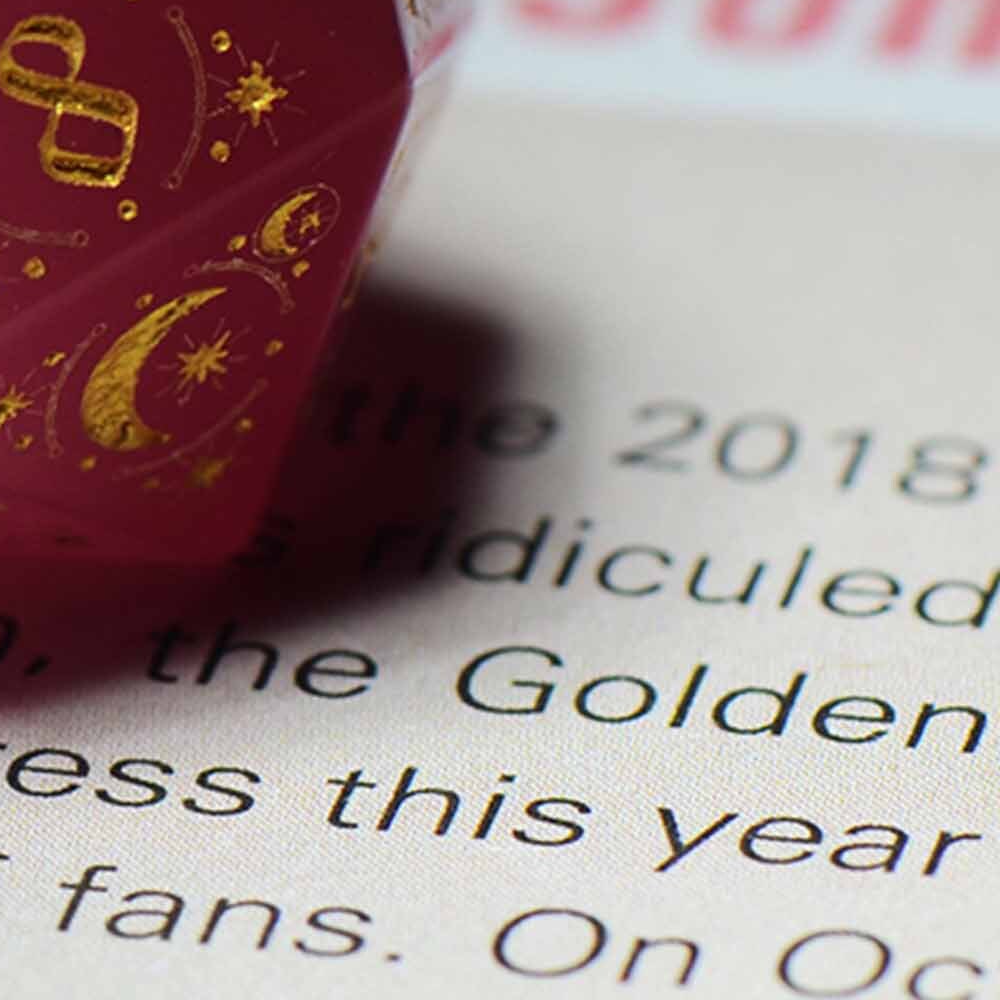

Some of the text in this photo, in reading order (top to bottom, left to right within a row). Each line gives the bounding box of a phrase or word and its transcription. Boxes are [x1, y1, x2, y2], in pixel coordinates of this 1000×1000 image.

[615, 398, 990, 505] 2018
[360, 508, 1000, 631] ridiculed
[146, 620, 378, 699] the
[455, 646, 989, 755] Golden
[327, 767, 592, 848] this
[654, 808, 983, 877] year
[57, 865, 403, 964] fans.
[491, 907, 702, 988] On
